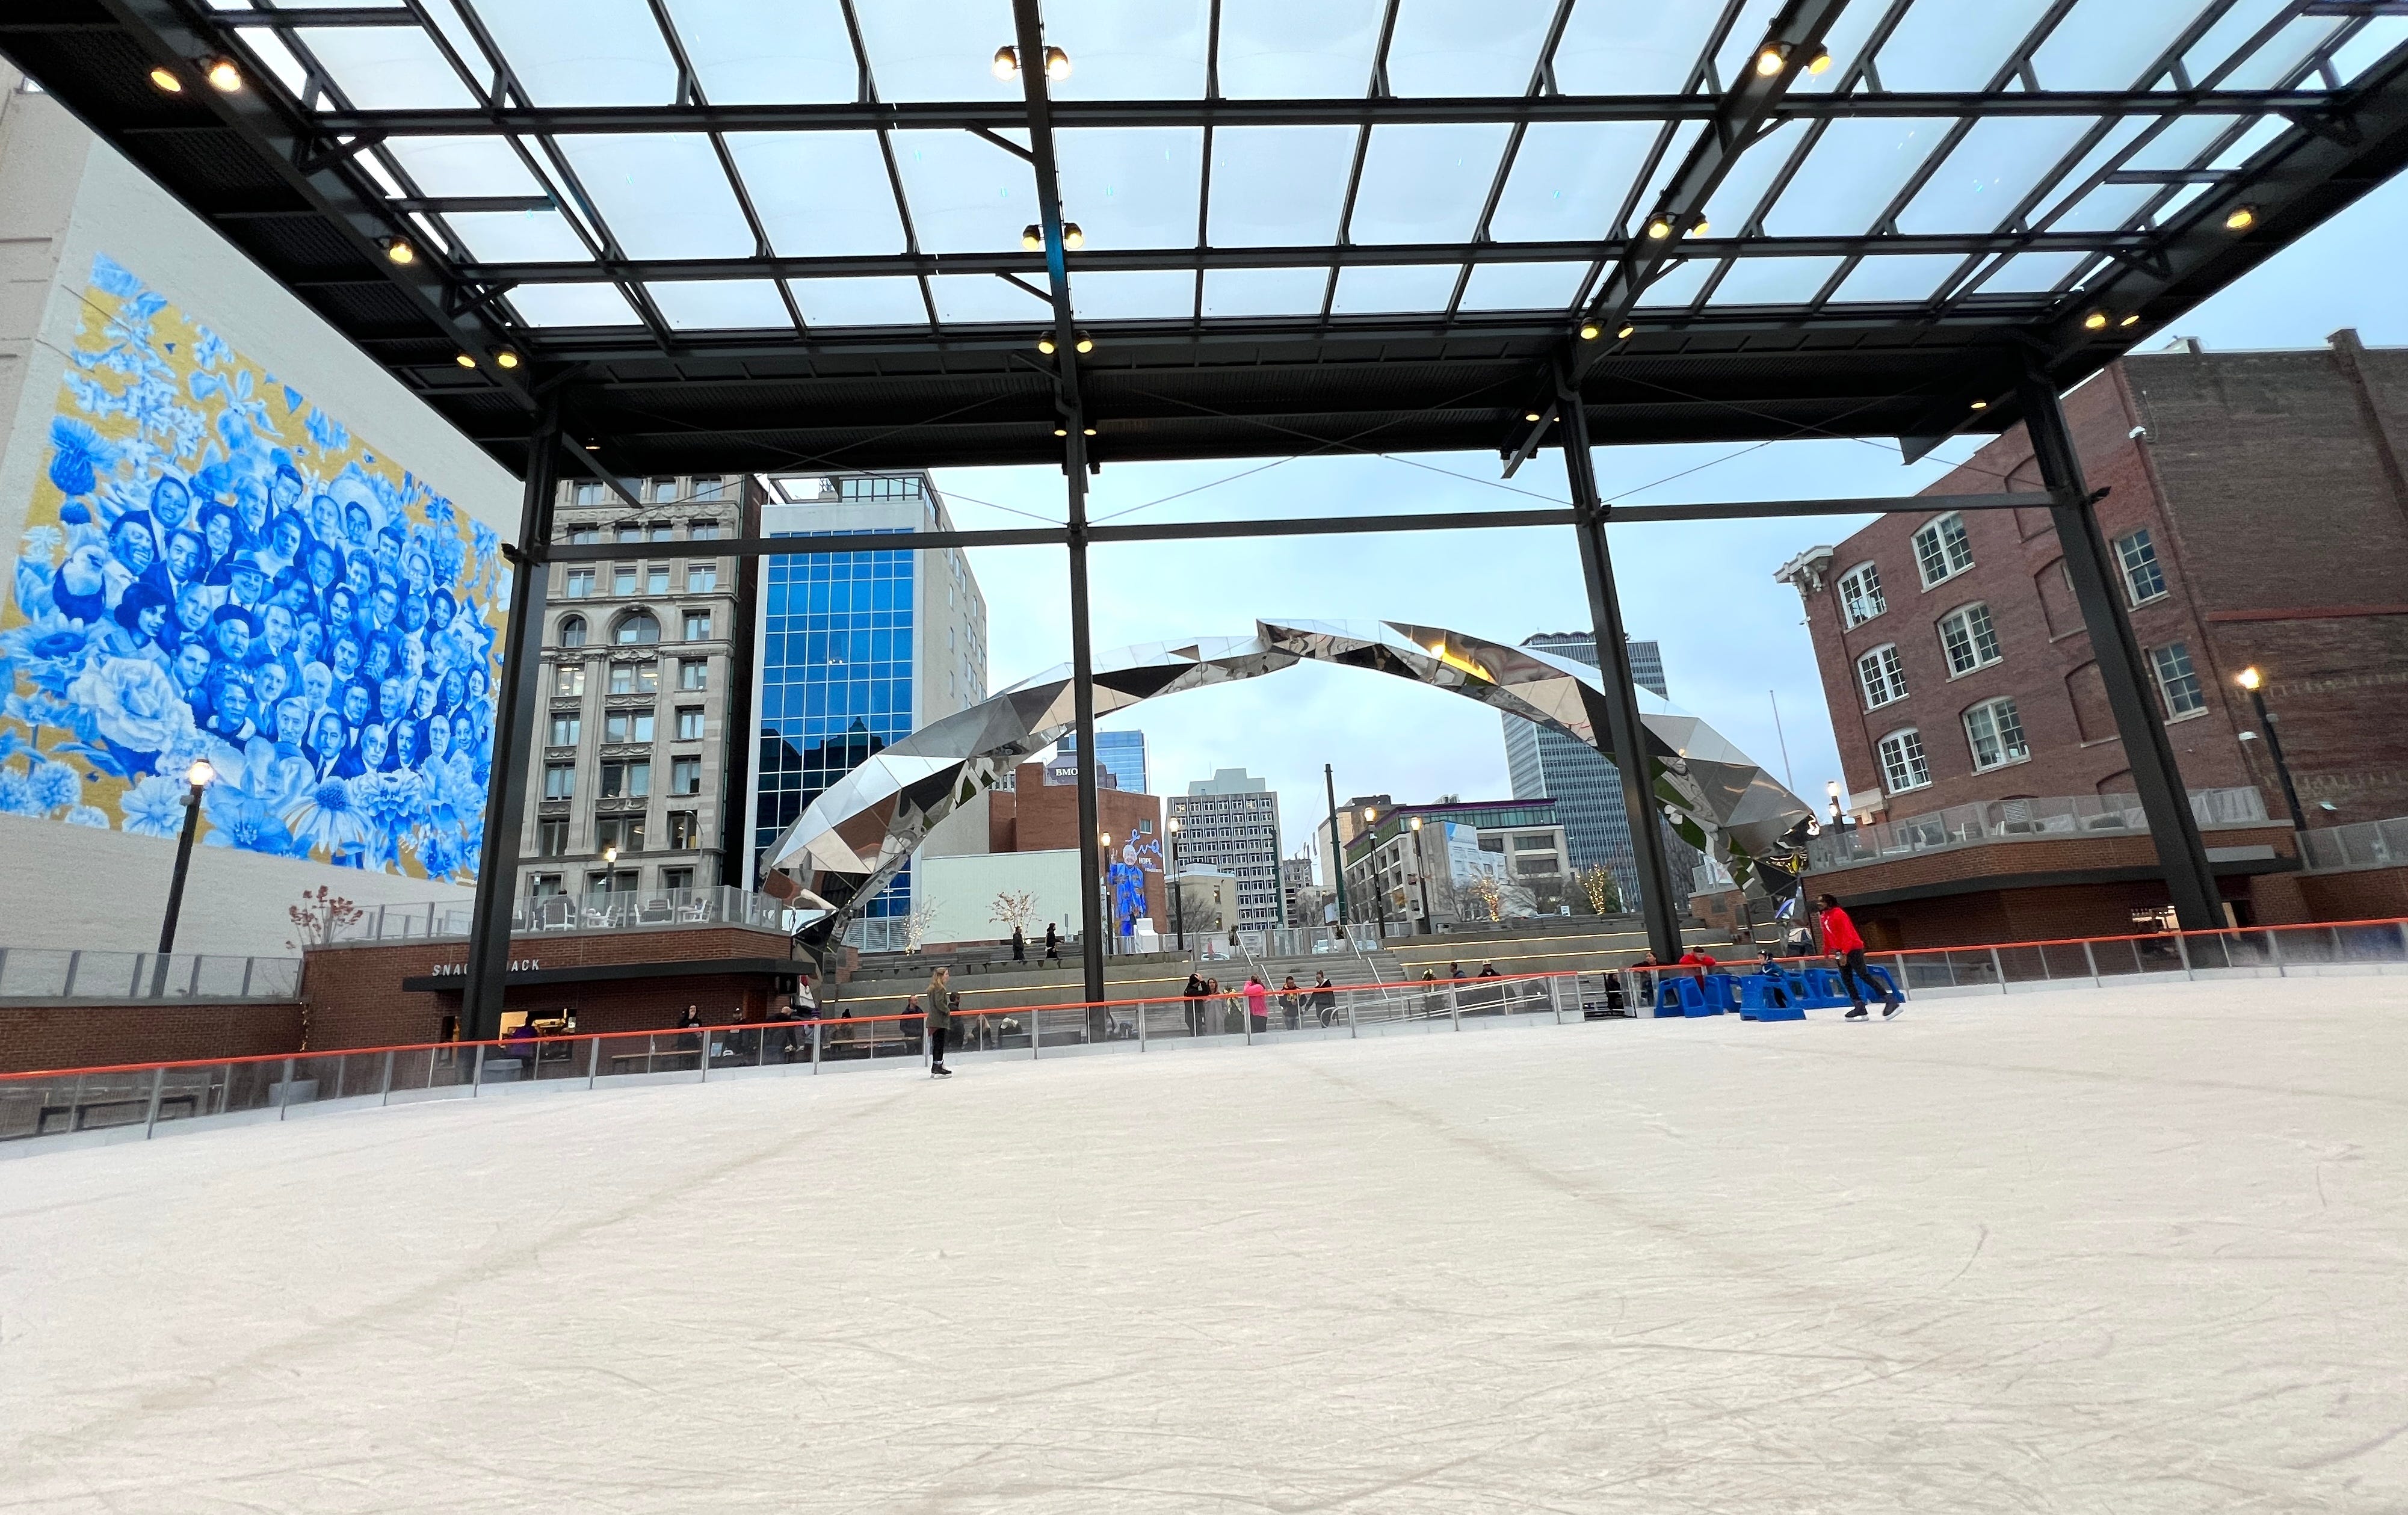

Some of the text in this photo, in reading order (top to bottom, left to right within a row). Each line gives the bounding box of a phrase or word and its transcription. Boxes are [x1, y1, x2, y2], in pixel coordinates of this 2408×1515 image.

[1055, 768, 1078, 776] BMO
[431, 959, 540, 977] SNA ACK
